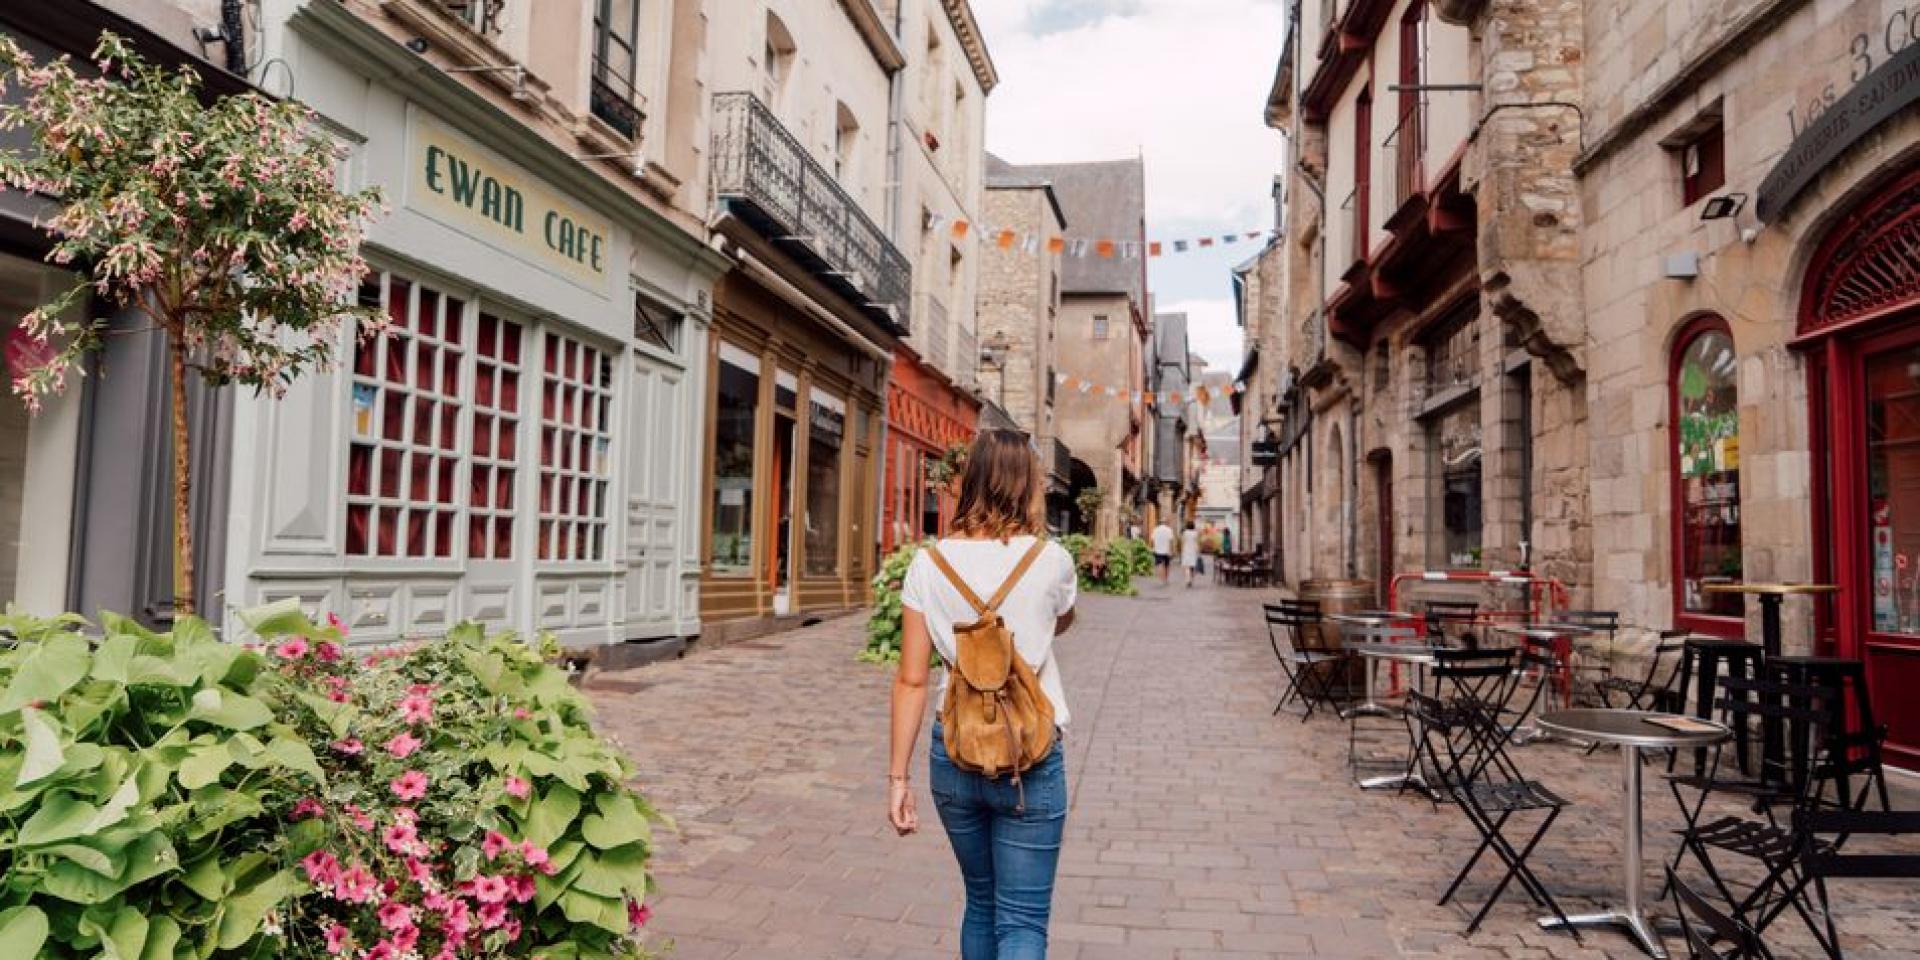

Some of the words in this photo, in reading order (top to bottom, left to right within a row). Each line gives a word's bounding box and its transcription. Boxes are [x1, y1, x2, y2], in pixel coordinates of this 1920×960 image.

[1786, 82, 1836, 140] Les
[1850, 33, 1873, 84] 3
[425, 144, 524, 234] EWAN
[544, 210, 603, 273] CAFE
